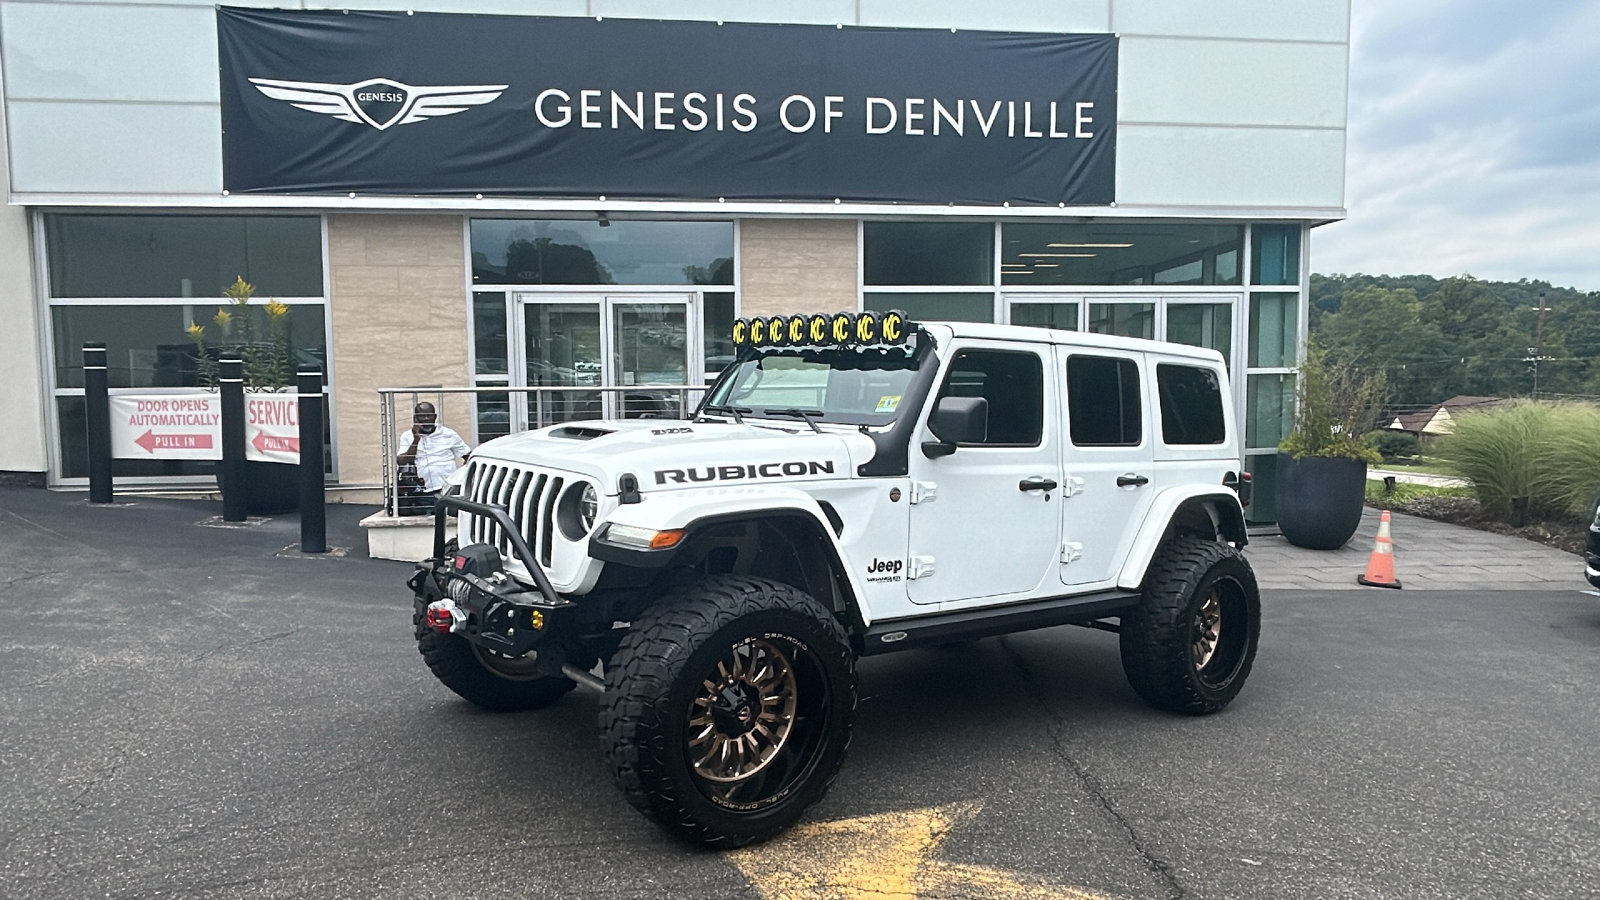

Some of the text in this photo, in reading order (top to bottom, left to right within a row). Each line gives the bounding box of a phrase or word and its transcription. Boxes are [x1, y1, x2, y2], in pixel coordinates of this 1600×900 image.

[358, 92, 403, 102] GENESIS
[534, 88, 1094, 138] GENESIS OF DENVILLE
[733, 321, 745, 344] KC
[751, 320, 763, 343] KC
[770, 319, 782, 343] KC
[789, 318, 803, 342] KC
[810, 316, 825, 342] KC
[832, 316, 848, 342] KC
[857, 315, 873, 341] KC
[883, 314, 900, 341] KC
[137, 400, 209, 412] DOOR OPENS
[129, 414, 219, 426] AUTOMATICALLY
[155, 436, 195, 447] PULL IN
[655, 460, 835, 485] RUBICON
[867, 557, 903, 574] Jeep
